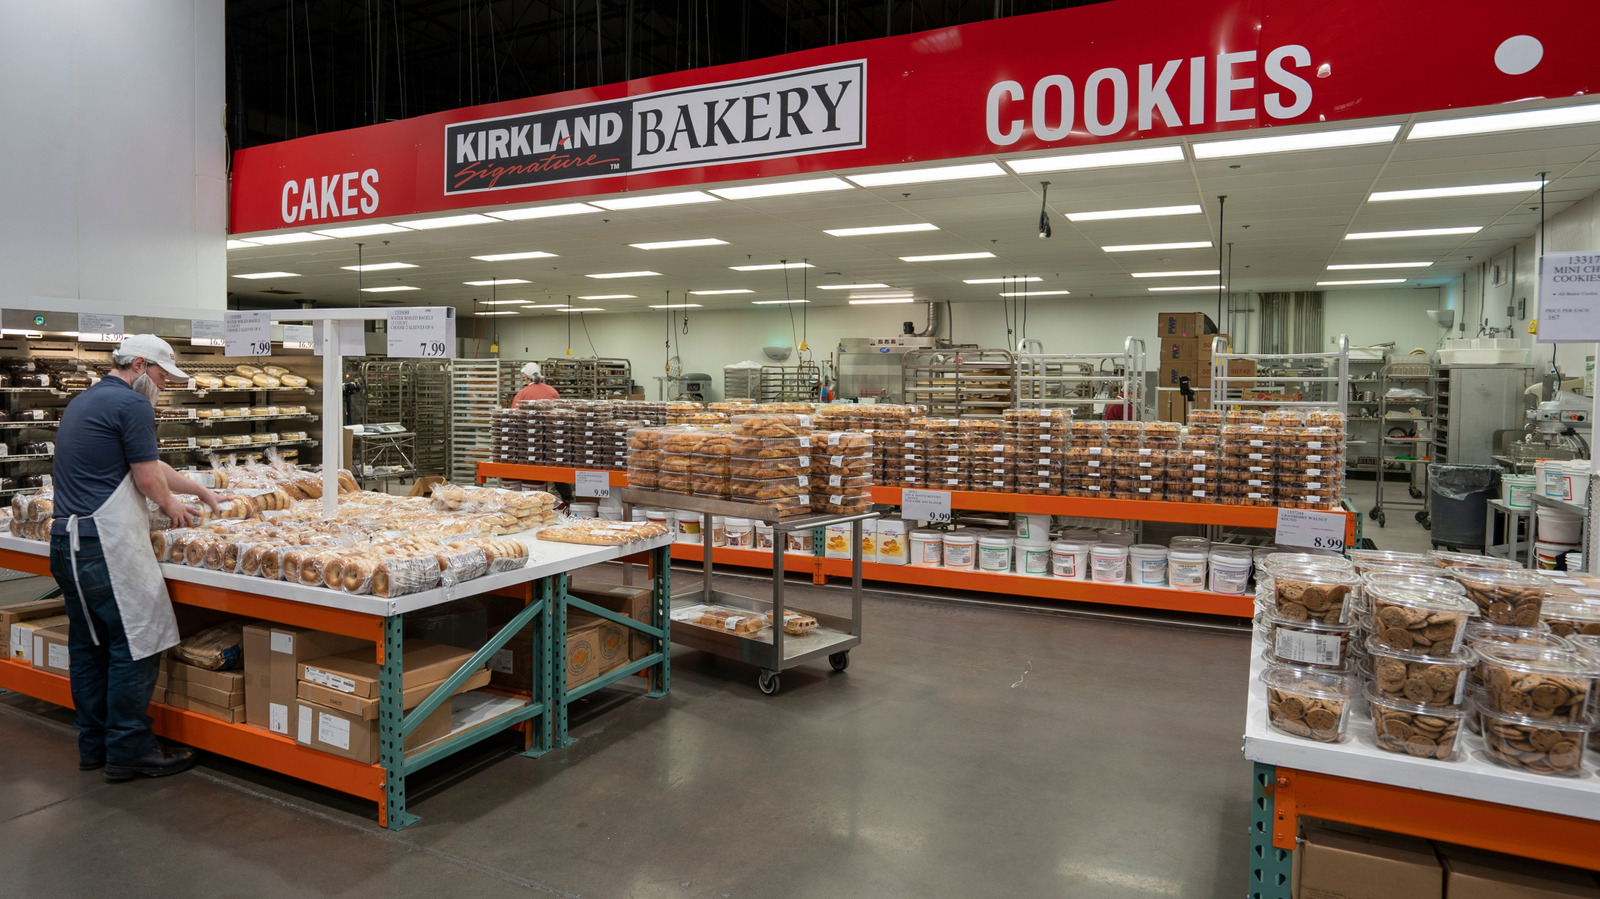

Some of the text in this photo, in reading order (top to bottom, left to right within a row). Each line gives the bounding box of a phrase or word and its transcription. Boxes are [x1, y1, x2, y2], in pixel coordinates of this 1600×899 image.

[986, 44, 1313, 146] COOKIES
[637, 80, 852, 156] BAKERY
[457, 112, 623, 164] KIRKLAND
[454, 154, 621, 189] Signature
[281, 168, 380, 223] CAKES
[1554, 266, 1580, 274] MINI
[1168, 317, 1177, 334] PWP
[101, 333, 123, 342] 15.99
[210, 337, 225, 346] 16.9
[250, 342, 271, 355] 7.99
[420, 342, 446, 357] 7.99
[594, 489, 609, 497] 9.99
[930, 512, 950, 522] 9.99
[1314, 536, 1343, 549] 8.99
